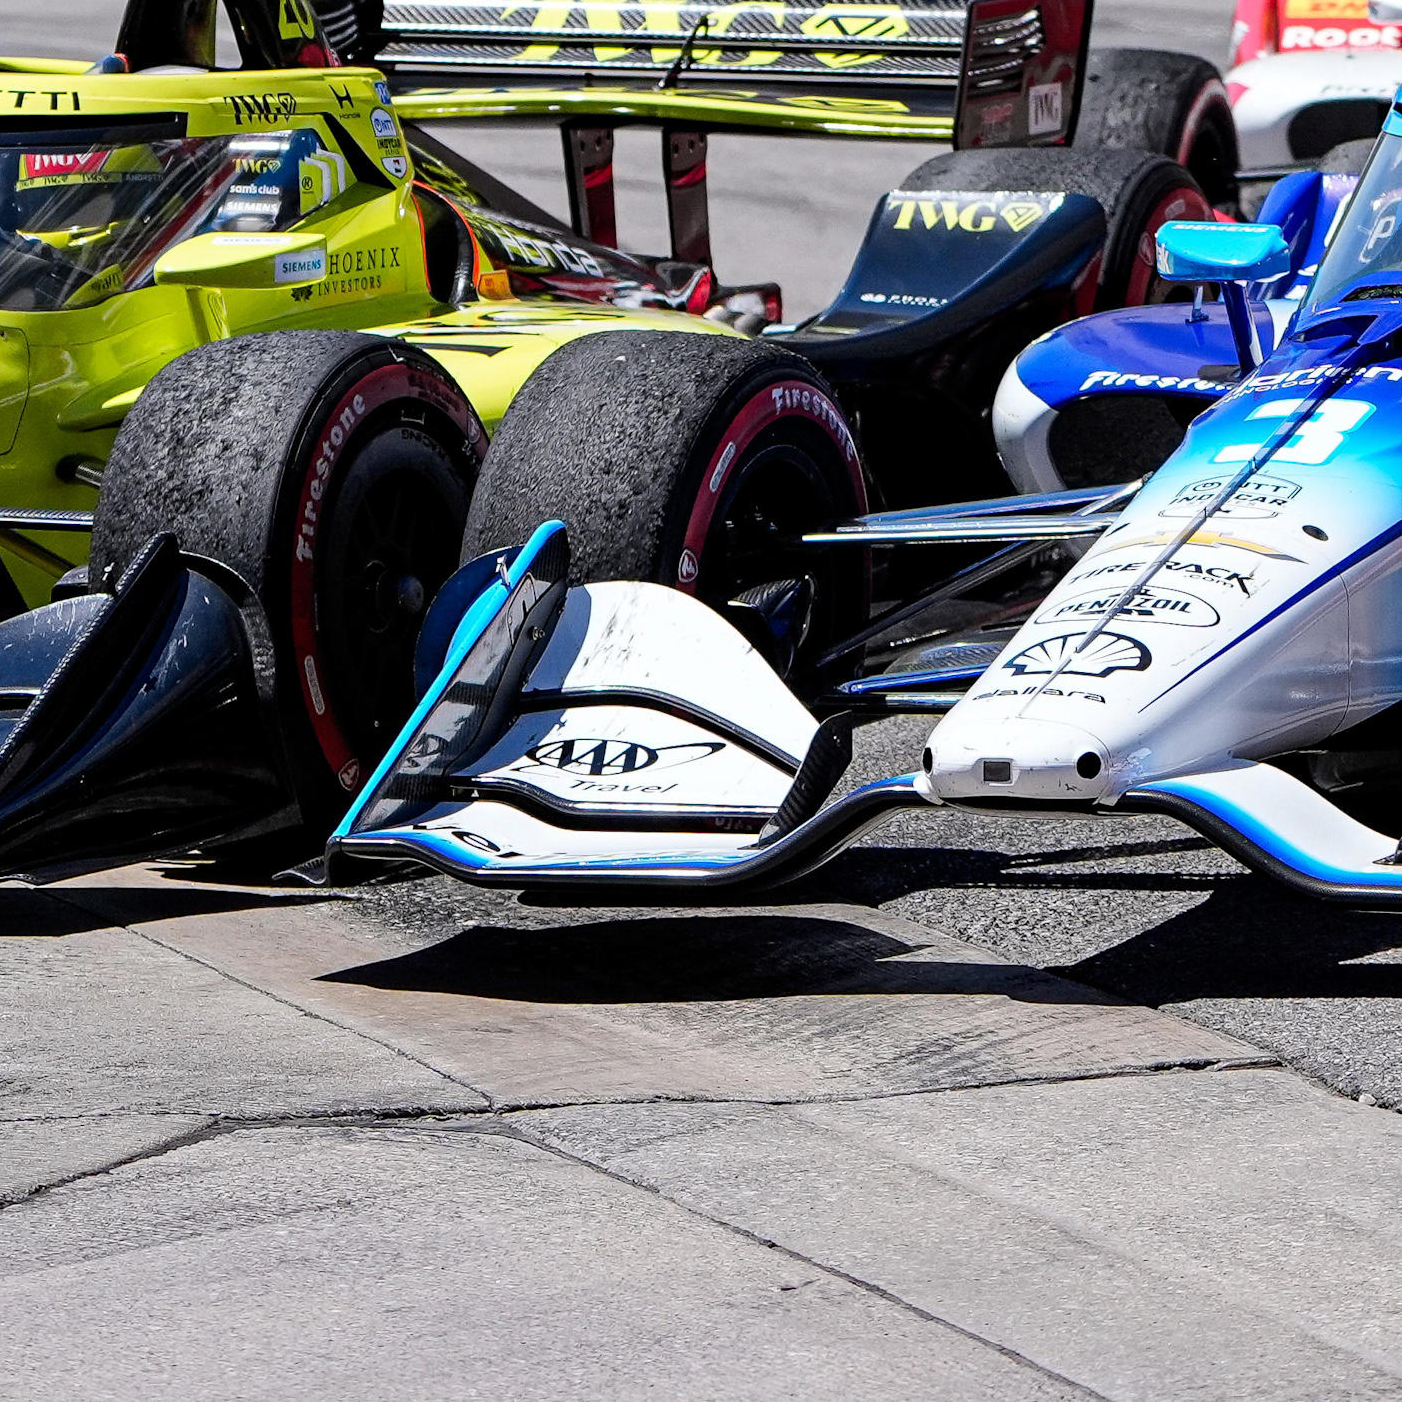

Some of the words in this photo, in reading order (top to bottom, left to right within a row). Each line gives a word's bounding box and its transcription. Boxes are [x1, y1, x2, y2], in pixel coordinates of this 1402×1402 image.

[1282, 25, 1402, 49] Root
[224, 93, 281, 125] TWG
[232, 158, 268, 175] TWG
[230, 183, 257, 195] sam's
[258, 184, 280, 196] club
[225, 200, 280, 212] SIEMENS
[888, 199, 997, 233] TWG
[1171, 224, 1269, 234] SIEMENS
[329, 246, 401, 276] HOENIX
[486, 223, 605, 278] Honda
[281, 258, 322, 274] SIEMENS
[318, 275, 382, 297] INVESTORS
[771, 386, 855, 462] Firestone
[1209, 399, 1378, 465] 3
[296, 394, 366, 563] Firestone
[973, 686, 1106, 704] dallara
[536, 739, 641, 776] AAA
[568, 779, 680, 794] Travel
